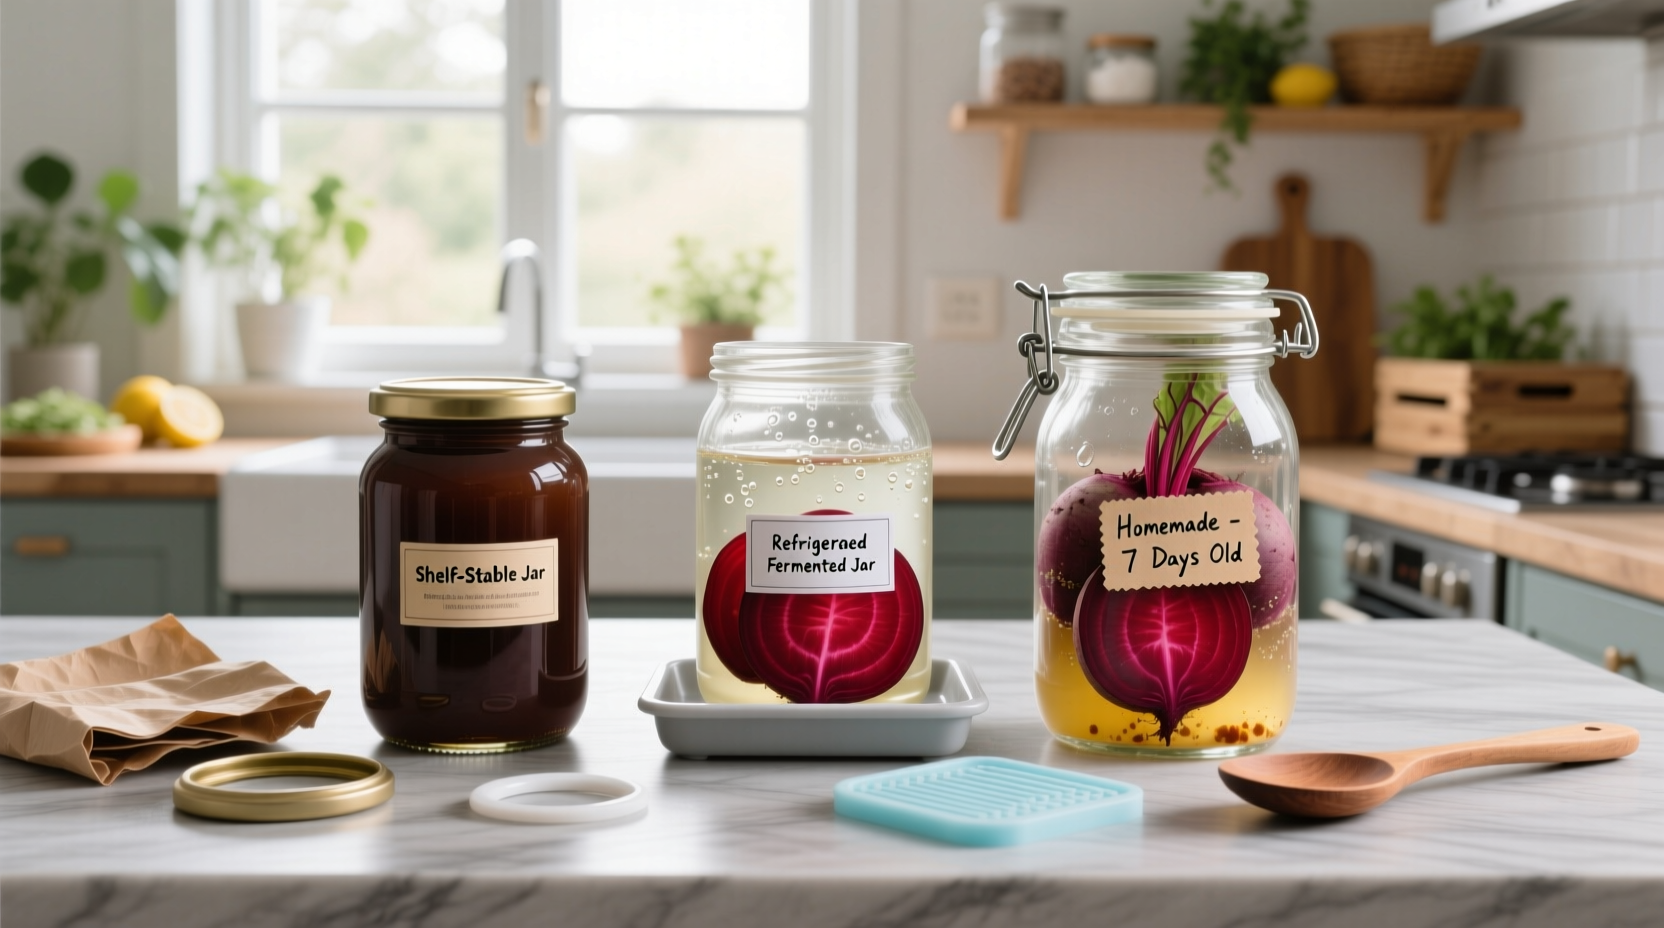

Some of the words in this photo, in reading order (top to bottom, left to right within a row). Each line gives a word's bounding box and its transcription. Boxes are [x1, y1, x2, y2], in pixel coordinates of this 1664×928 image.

[1117, 511, 1220, 540] Homemade
[767, 557, 847, 574] Fermented
[850, 557, 876, 573] Jar
[1121, 548, 1138, 574] 7
[1152, 546, 1200, 578] Days
[1209, 541, 1243, 563] Old
[415, 565, 517, 584] Shelf-Stable
[521, 564, 546, 582] Jar
